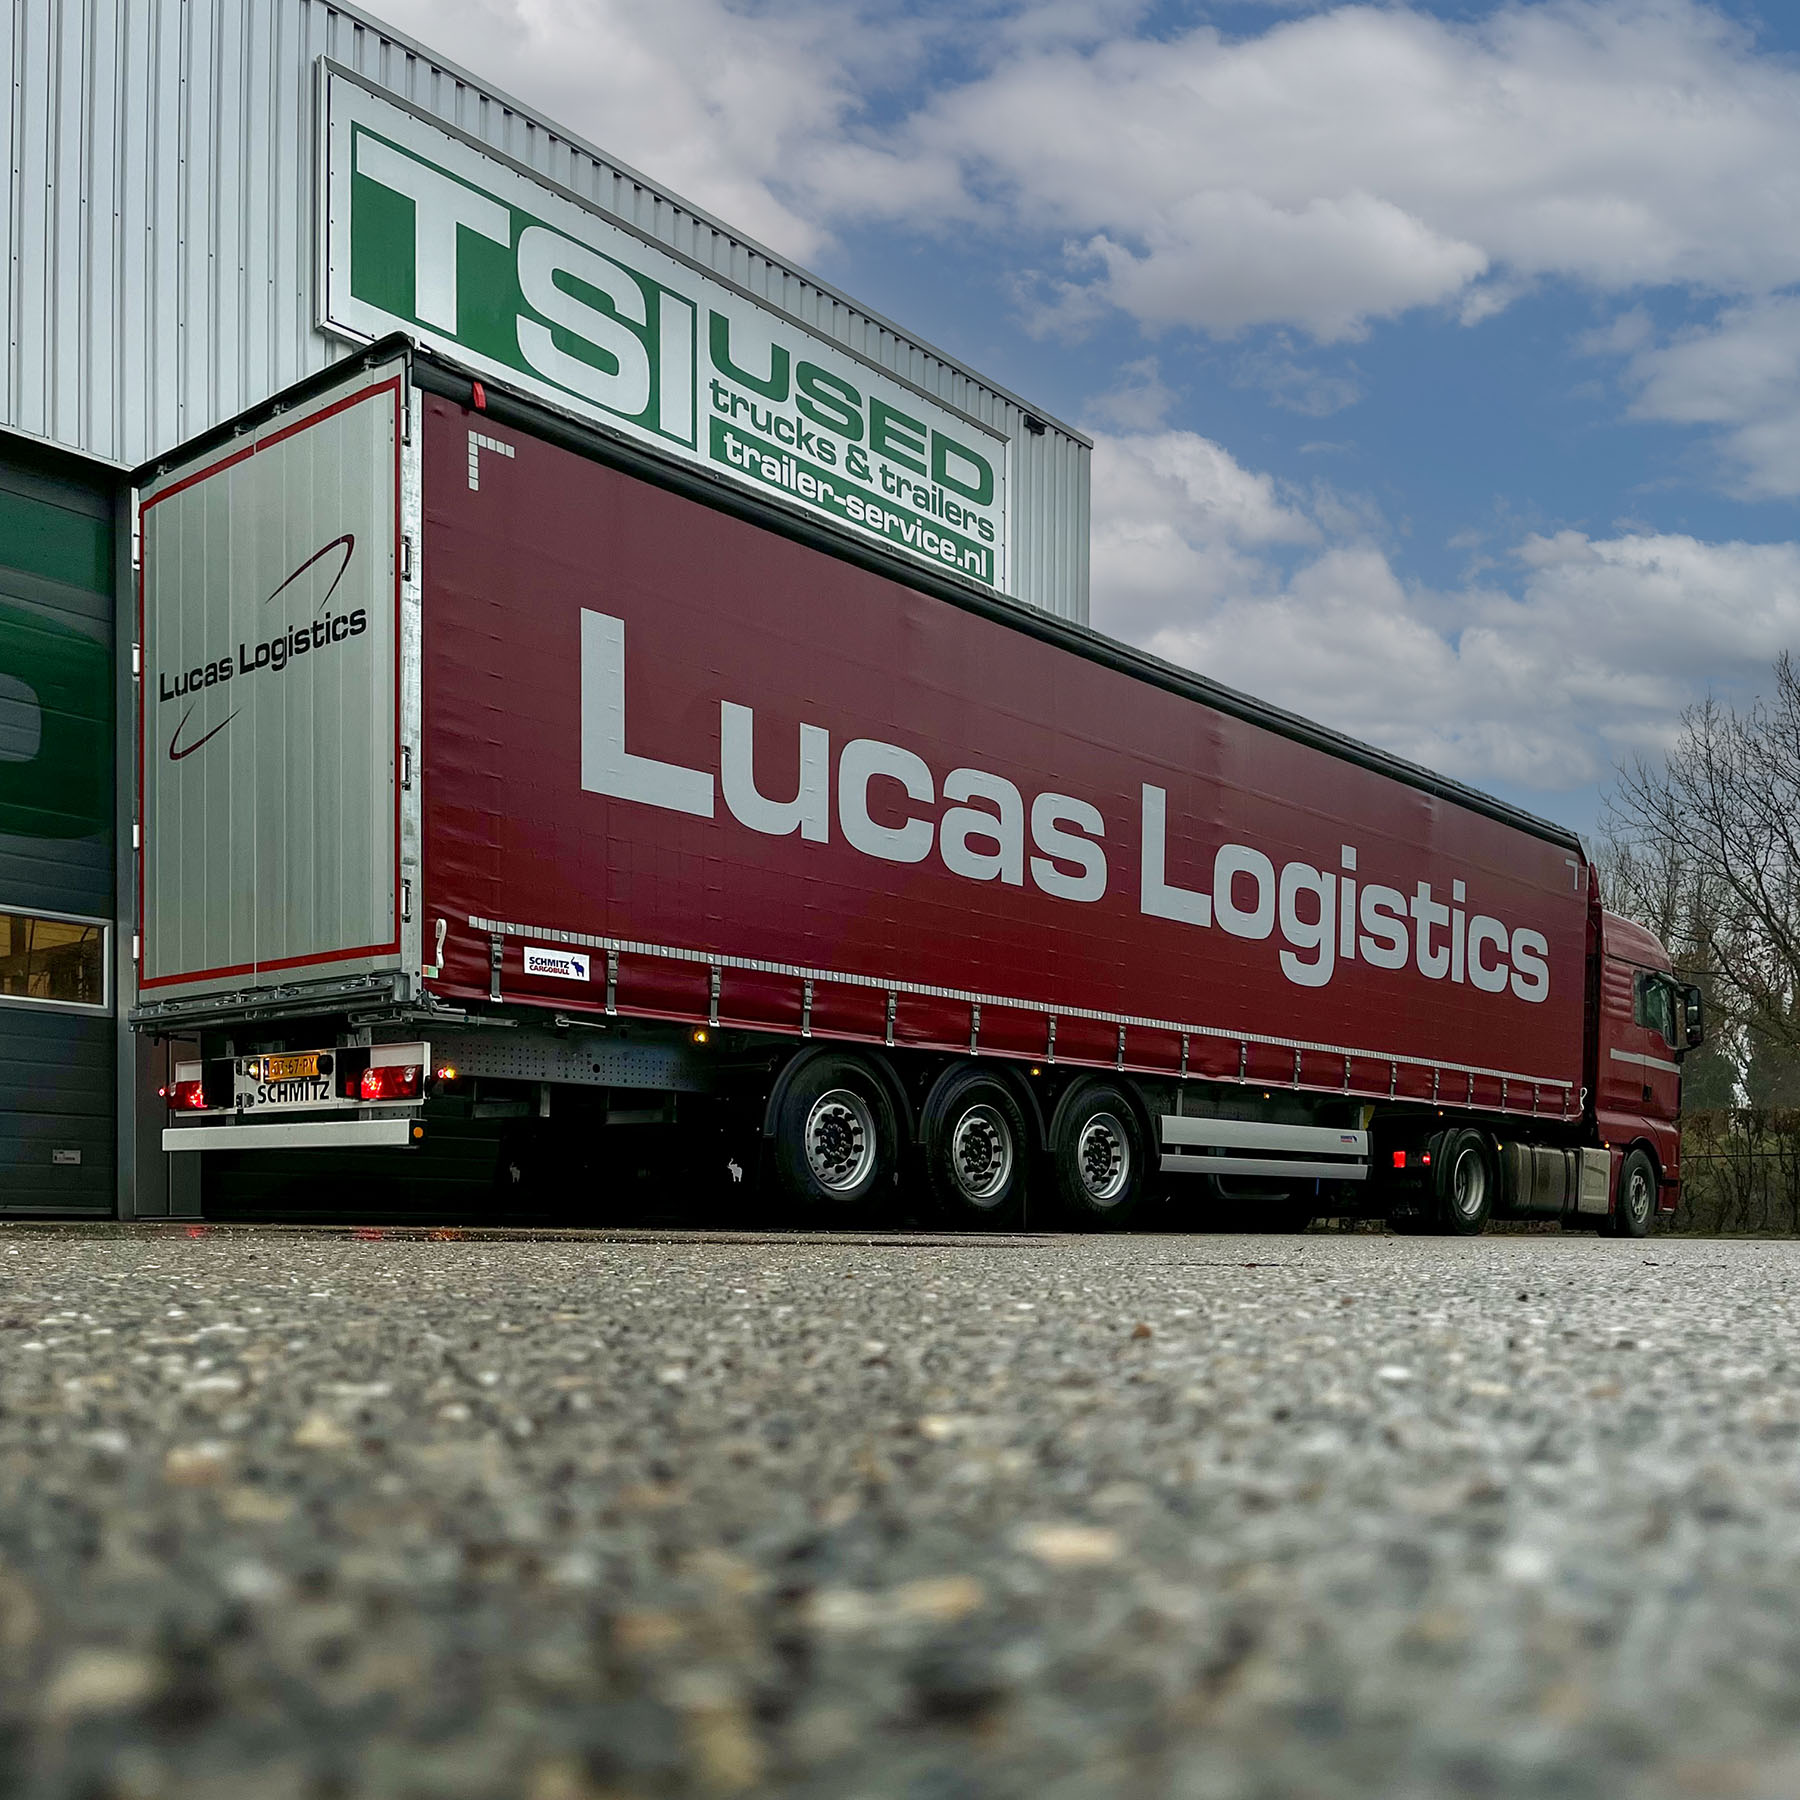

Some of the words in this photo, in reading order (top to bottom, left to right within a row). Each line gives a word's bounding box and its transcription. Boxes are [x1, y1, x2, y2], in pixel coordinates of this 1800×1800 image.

[355, 130, 693, 444] TSI
[709, 309, 994, 507] USED
[709, 377, 837, 466] trucks
[845, 443, 873, 484] &
[879, 463, 995, 543] trailers
[723, 431, 988, 578] trailer-service.nl
[160, 656, 234, 702] Lucas
[239, 608, 367, 675] Logistics
[580, 607, 1108, 902] Lucas
[1140, 782, 1550, 1003] Logistics
[529, 956, 570, 969] SCHMITZ
[529, 965, 570, 976] CARGOBULL
[257, 1081, 330, 1104] SCHMITZ
